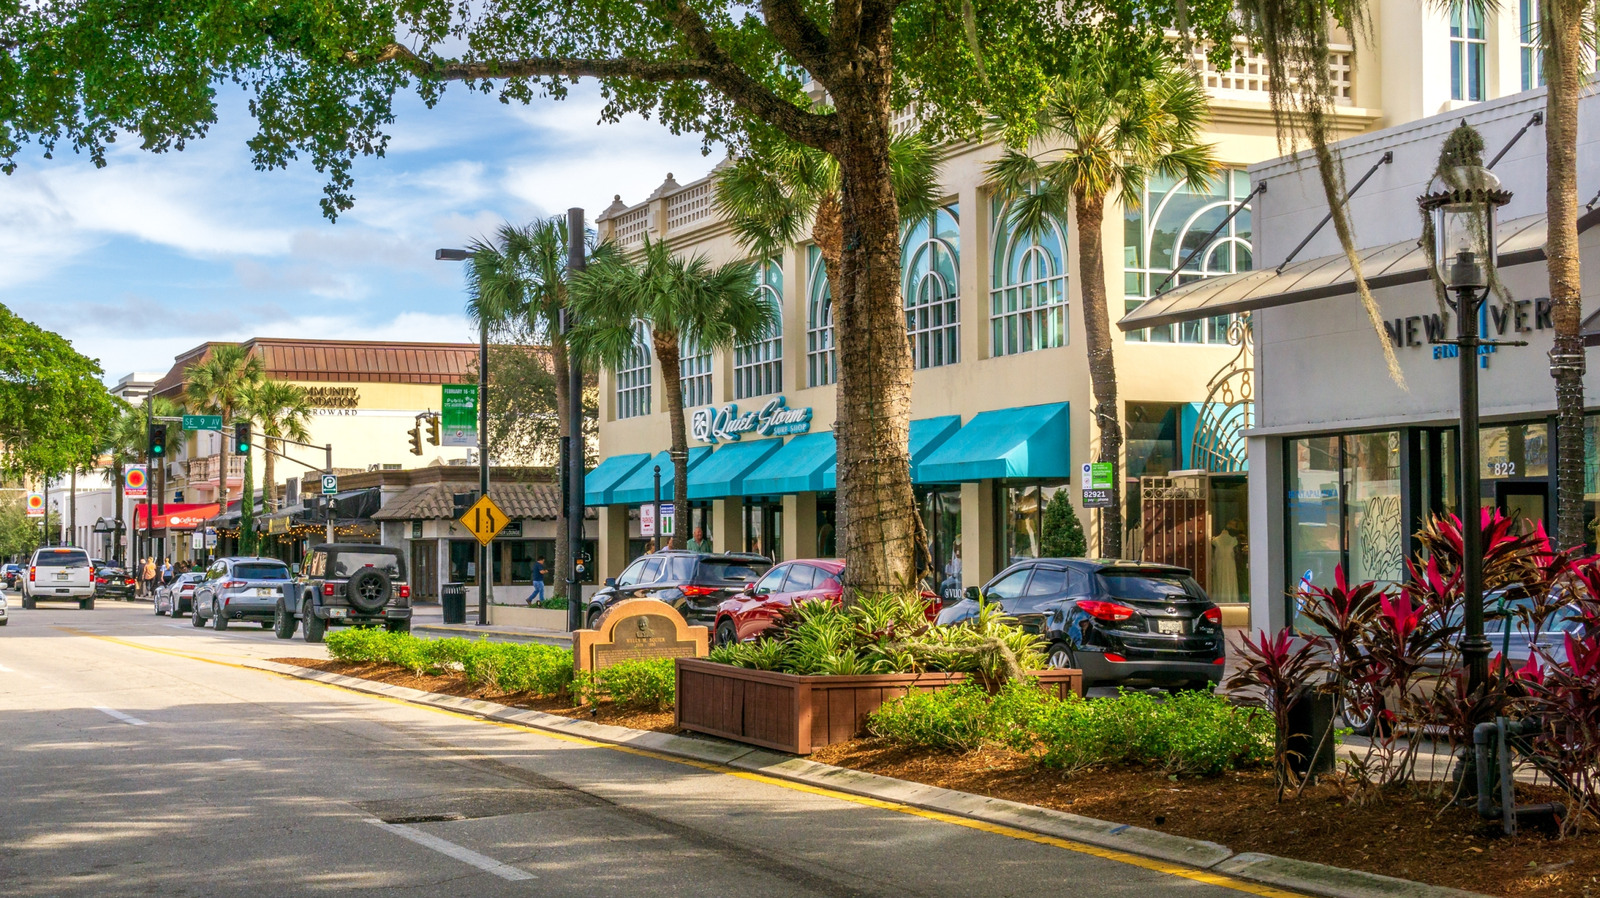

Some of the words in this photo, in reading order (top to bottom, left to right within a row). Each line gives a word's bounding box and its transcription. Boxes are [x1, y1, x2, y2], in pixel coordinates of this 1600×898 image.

[1383, 311, 1449, 348] NEW
[307, 408, 358, 416] ROWARD
[184, 417, 194, 426] SE
[200, 417, 205, 426] 9
[211, 418, 220, 426] AV
[712, 404, 757, 441] Quiet
[757, 396, 810, 436] Storm
[790, 423, 807, 431] SHOP
[1494, 461, 1516, 476] 822
